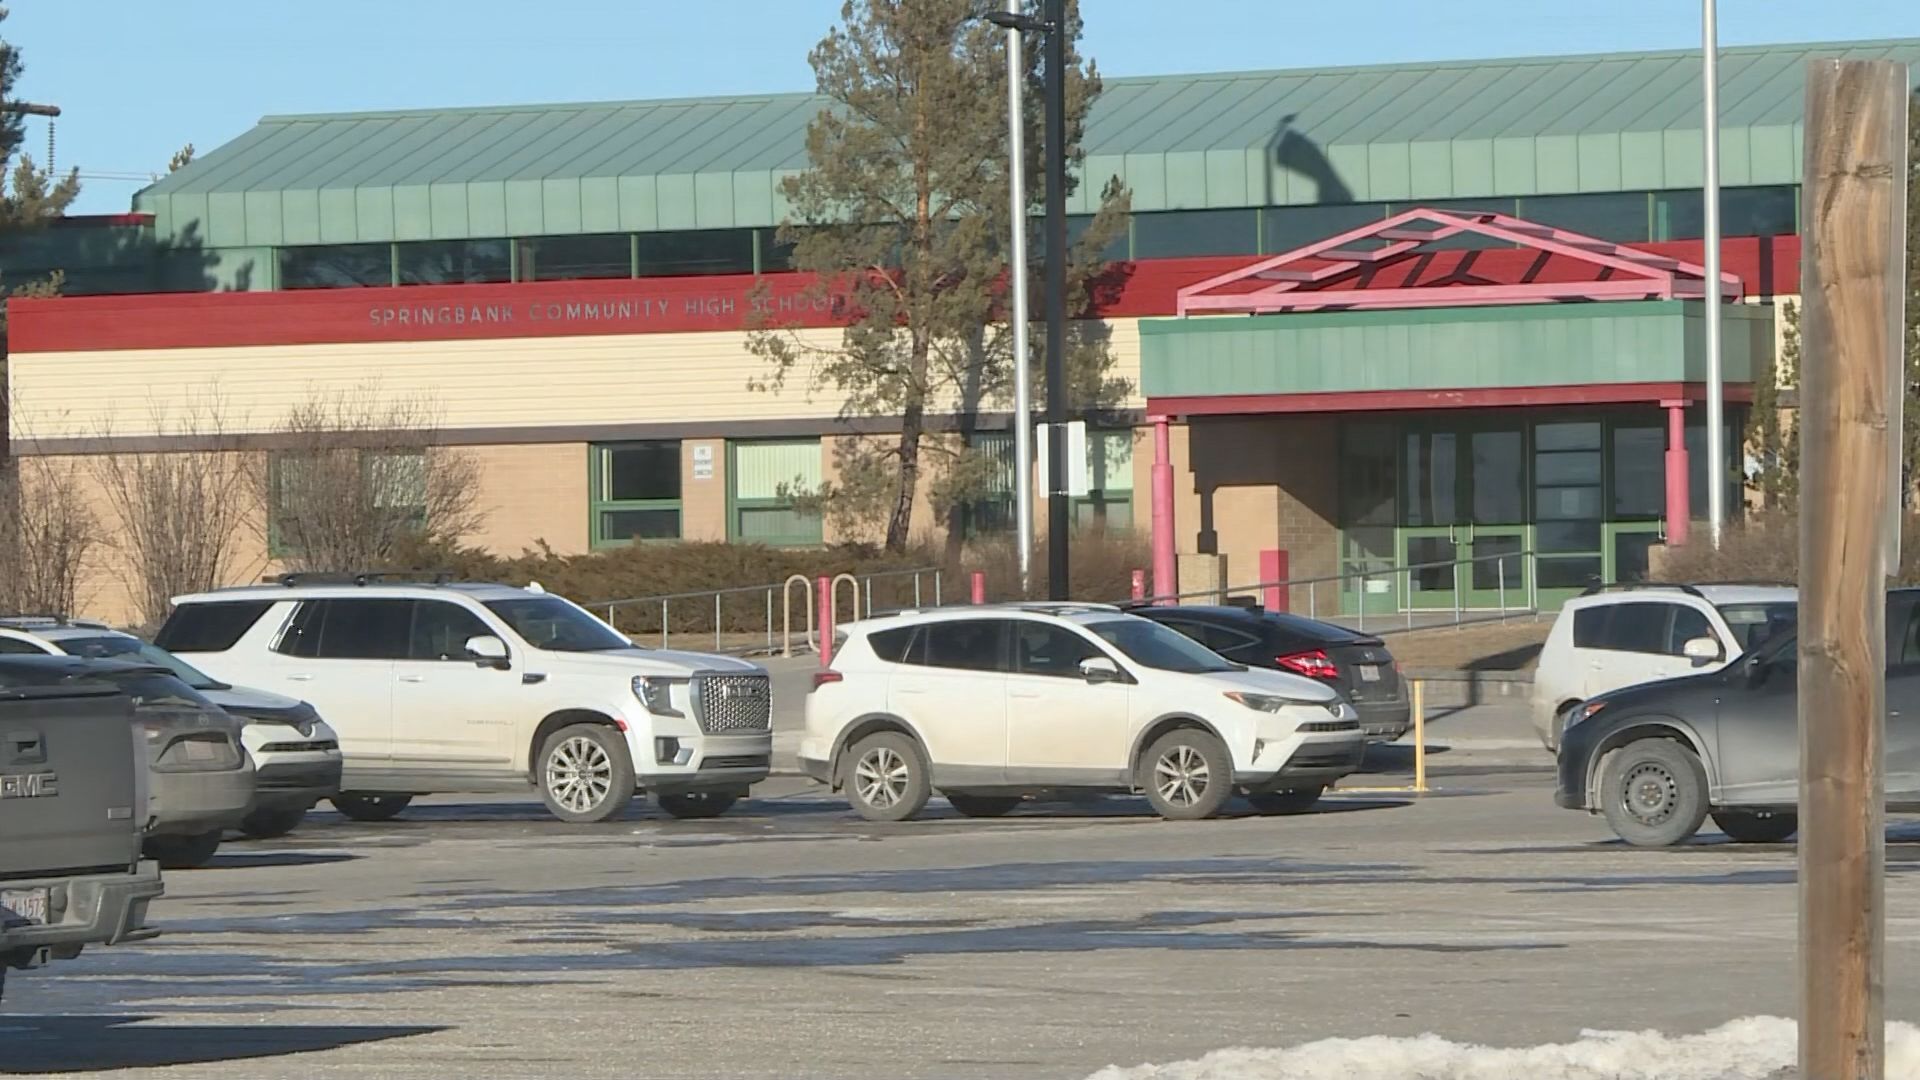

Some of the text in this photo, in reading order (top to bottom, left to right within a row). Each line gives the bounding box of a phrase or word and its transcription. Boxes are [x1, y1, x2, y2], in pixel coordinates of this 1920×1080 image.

[369, 304, 513, 326] SPRINGBANK
[529, 300, 669, 321] COMMUNITY
[685, 297, 735, 316] HIGH
[0, 773, 56, 798] GMC
